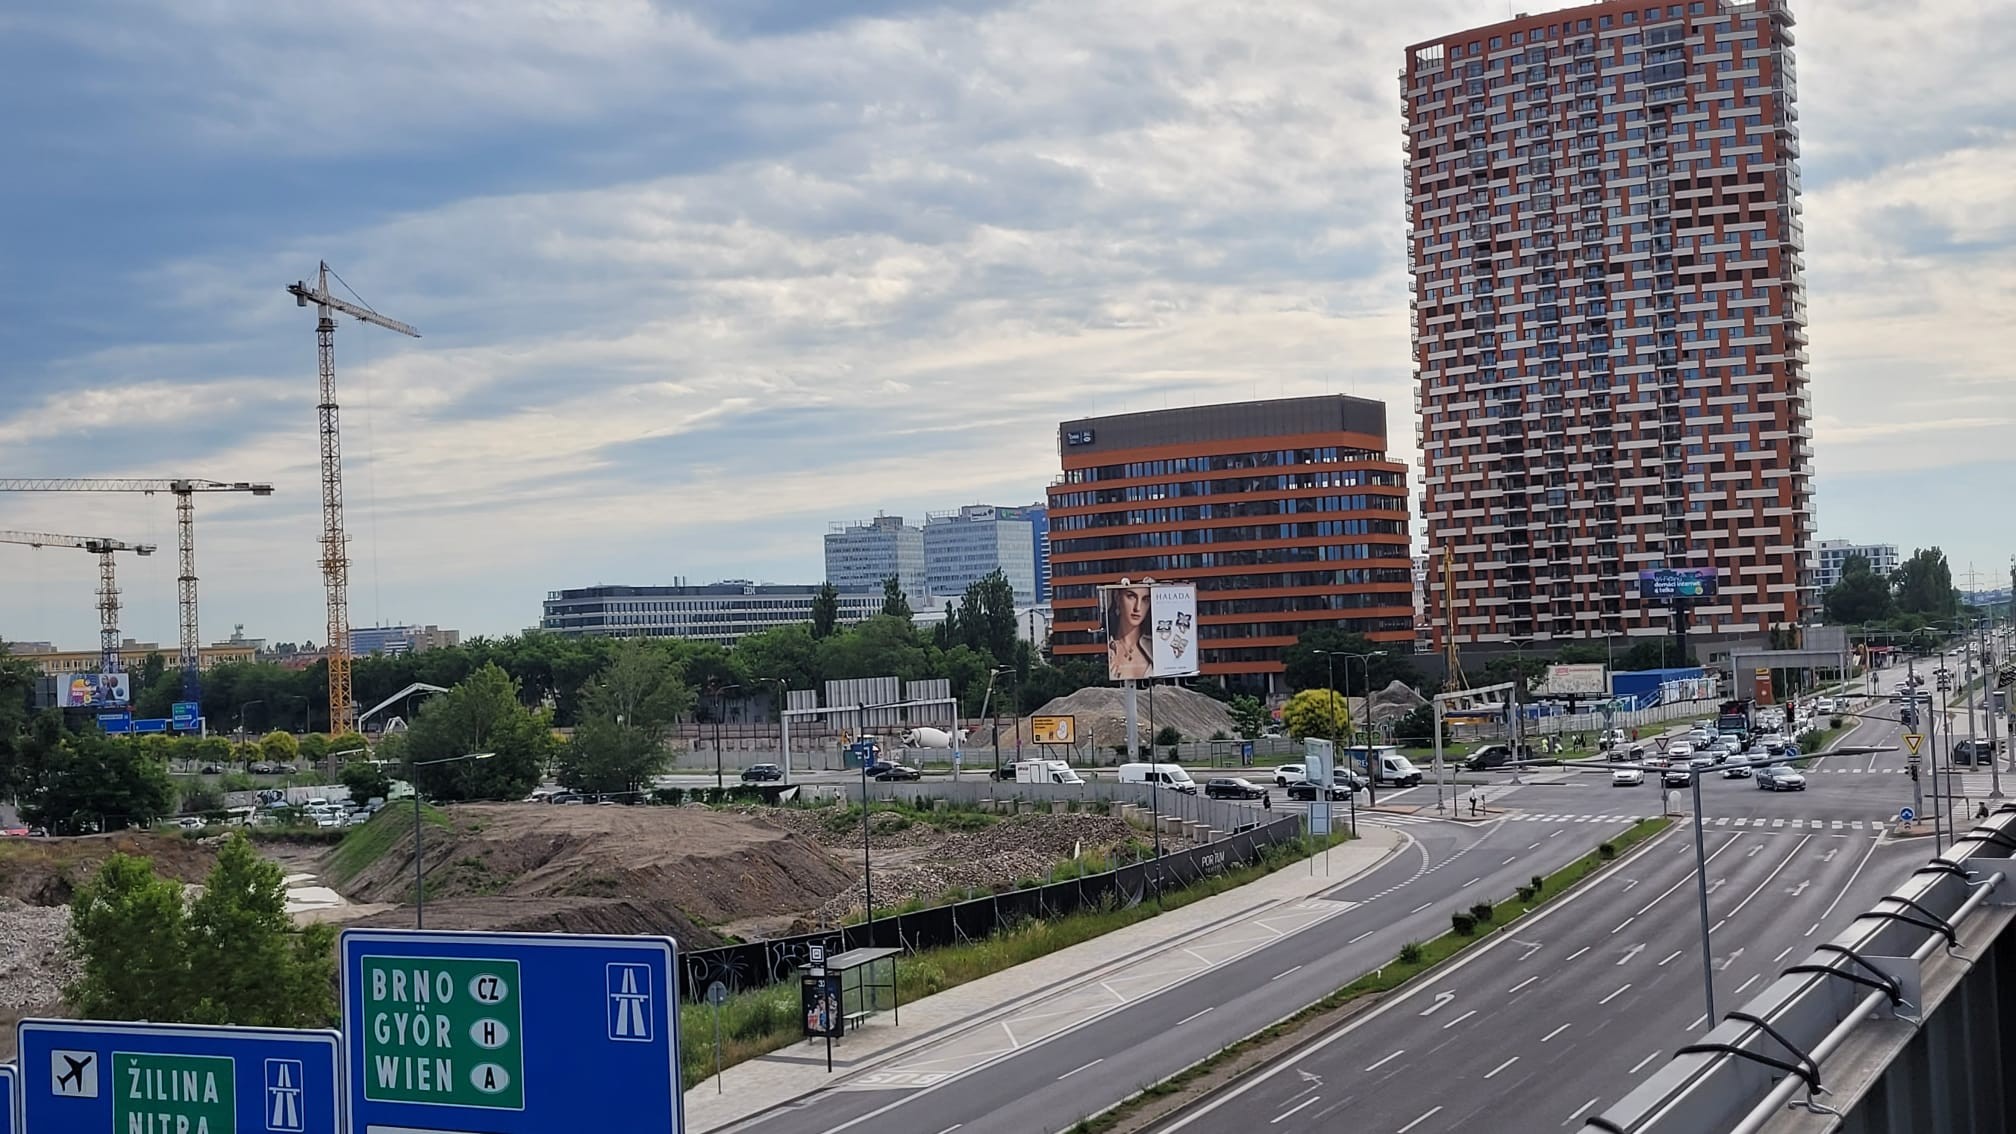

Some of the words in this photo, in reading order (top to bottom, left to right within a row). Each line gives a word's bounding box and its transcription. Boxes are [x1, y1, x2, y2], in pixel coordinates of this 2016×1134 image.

[372, 968, 454, 1004] BRNO
[477, 977, 499, 1001] CZ
[374, 1004, 452, 1048] GYÖR
[483, 1021, 495, 1045] H
[128, 1058, 219, 1104] ŽILINA
[375, 1055, 453, 1092] WIEN
[484, 1066, 496, 1089] A
[128, 1111, 210, 1134] NITRA
